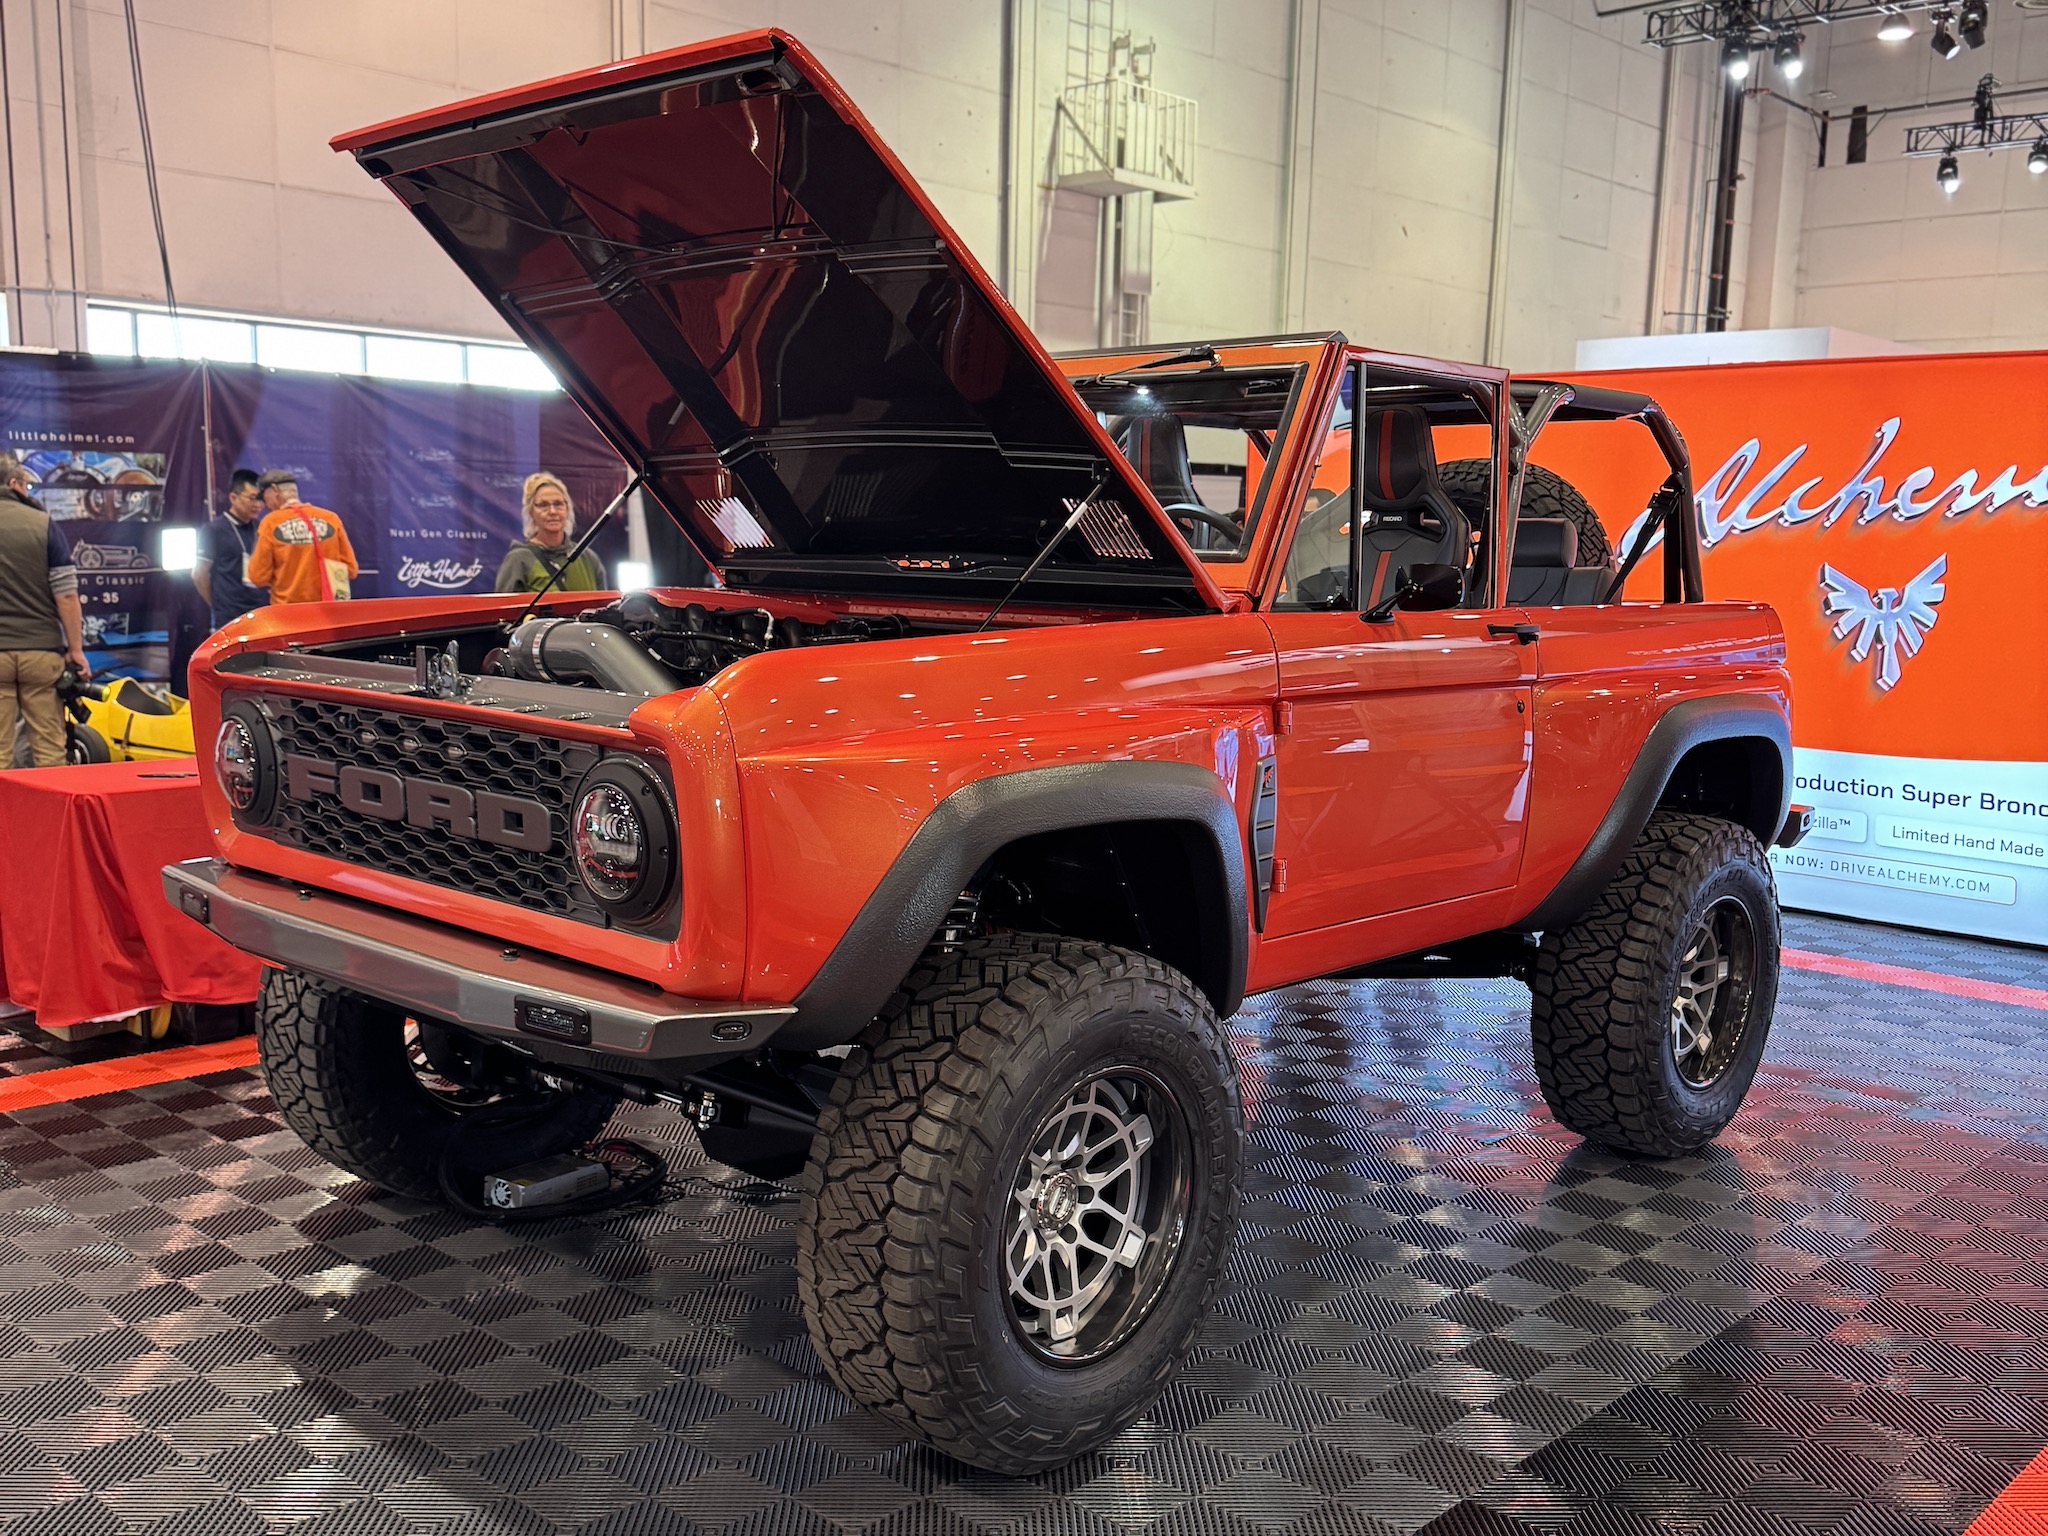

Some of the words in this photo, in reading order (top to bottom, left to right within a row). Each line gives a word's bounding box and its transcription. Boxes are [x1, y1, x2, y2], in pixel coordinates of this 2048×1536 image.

[8, 430, 135, 444] littlehelmet.com
[389, 528, 416, 538] Next
[420, 528, 442, 539] Gen
[446, 529, 488, 540] Classic
[96, 575, 145, 586] Classic
[102, 591, 120, 604] 35
[286, 753, 550, 852] FORD
[1793, 773, 1893, 799] oduction
[1902, 783, 1972, 809] Super
[1892, 825, 1949, 845] Limited
[1954, 833, 1995, 851] Hand
[2000, 839, 2044, 857] Made
[1785, 854, 1824, 869] NOW:
[1830, 860, 1991, 893] DRIVEALCHEMY.COM
